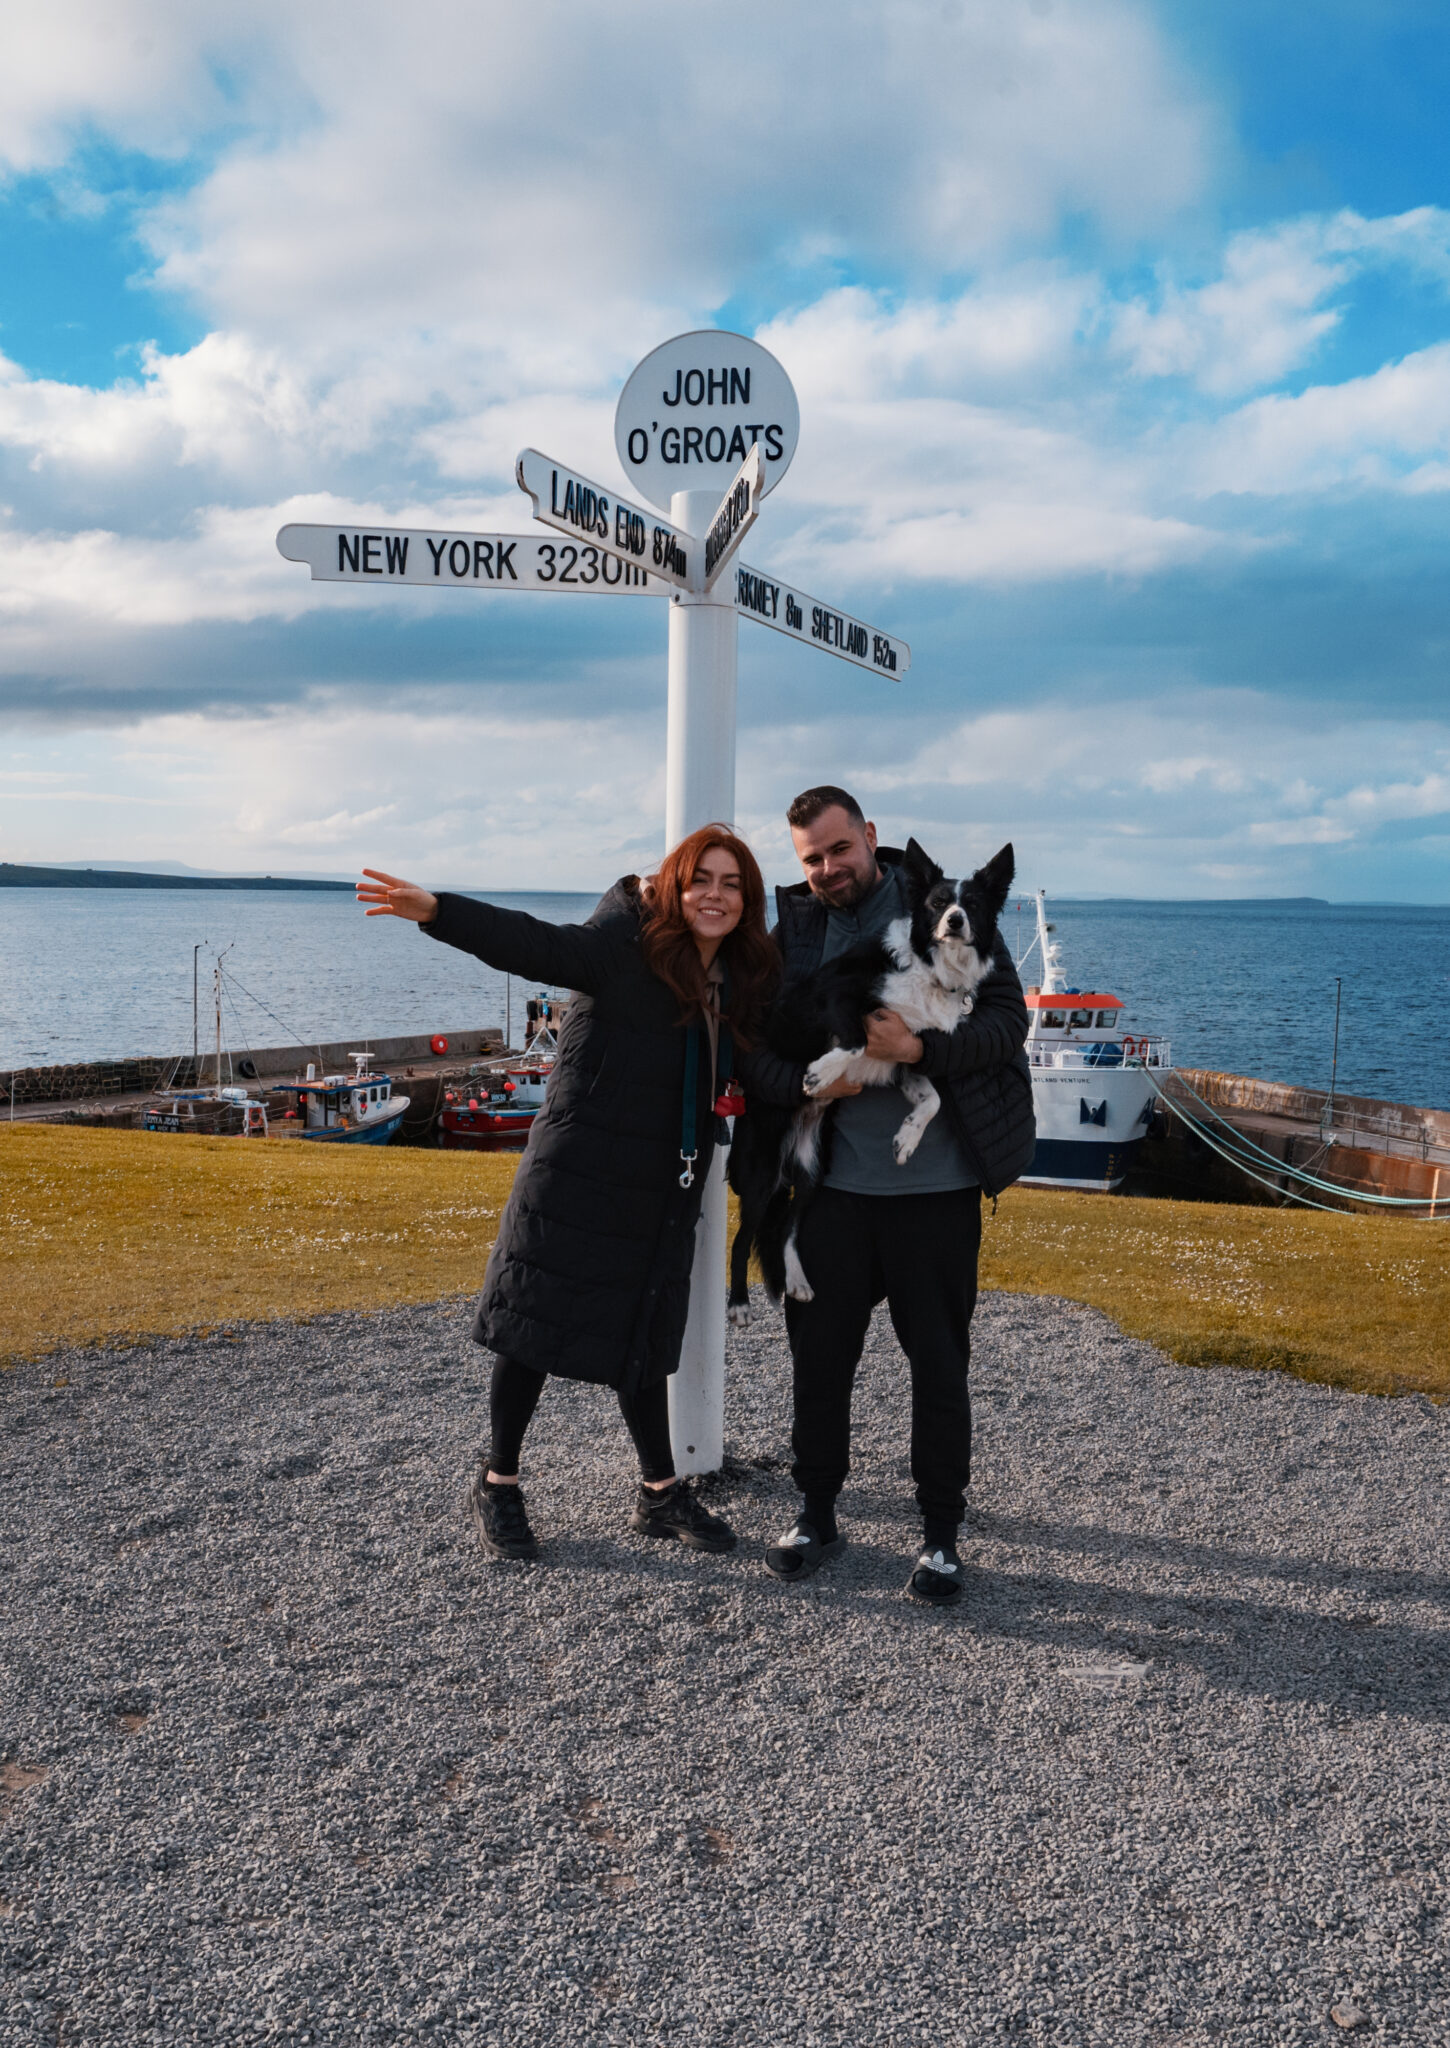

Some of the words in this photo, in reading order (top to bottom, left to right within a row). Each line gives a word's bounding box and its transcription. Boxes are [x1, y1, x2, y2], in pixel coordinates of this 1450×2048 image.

[662, 367, 751, 407] JOHN
[628, 421, 784, 465] O'GROATS
[552, 470, 609, 539] LANDS
[615, 504, 646, 556] END
[652, 526, 687, 578] 874m
[338, 534, 409, 575] NEW
[426, 538, 518, 580] YORK
[737, 568, 780, 619] RKNEY
[785, 593, 803, 631] 8m
[811, 606, 869, 659] SHETLAND
[872, 634, 897, 672] 152m
